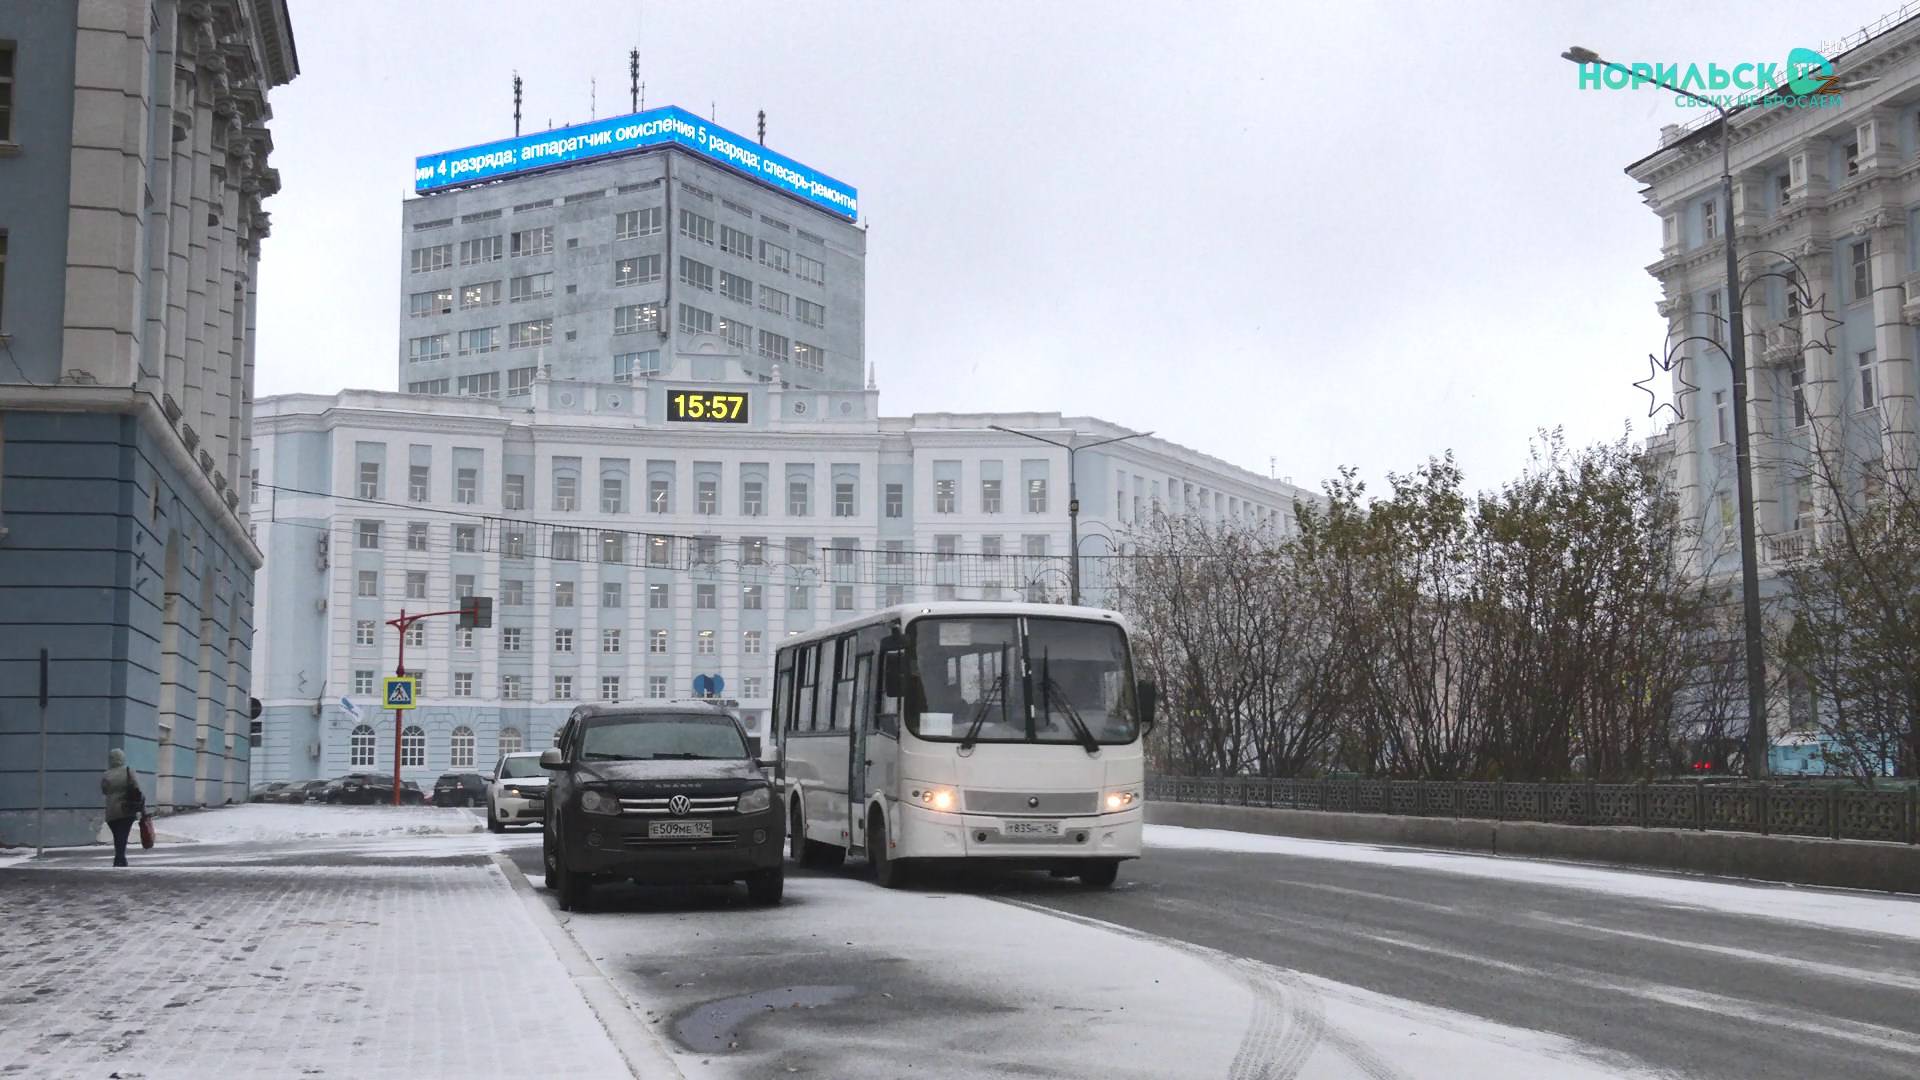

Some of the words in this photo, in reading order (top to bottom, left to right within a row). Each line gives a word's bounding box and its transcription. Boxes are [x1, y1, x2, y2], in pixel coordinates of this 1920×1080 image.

[437, 159, 447, 176] 4
[451, 148, 517, 178] разряда;
[522, 130, 612, 160] аппаратчик
[615, 118, 695, 141] окисления
[697, 127, 707, 145] 5
[709, 134, 761, 171] разряда;
[674, 394, 743, 419] 15:57
